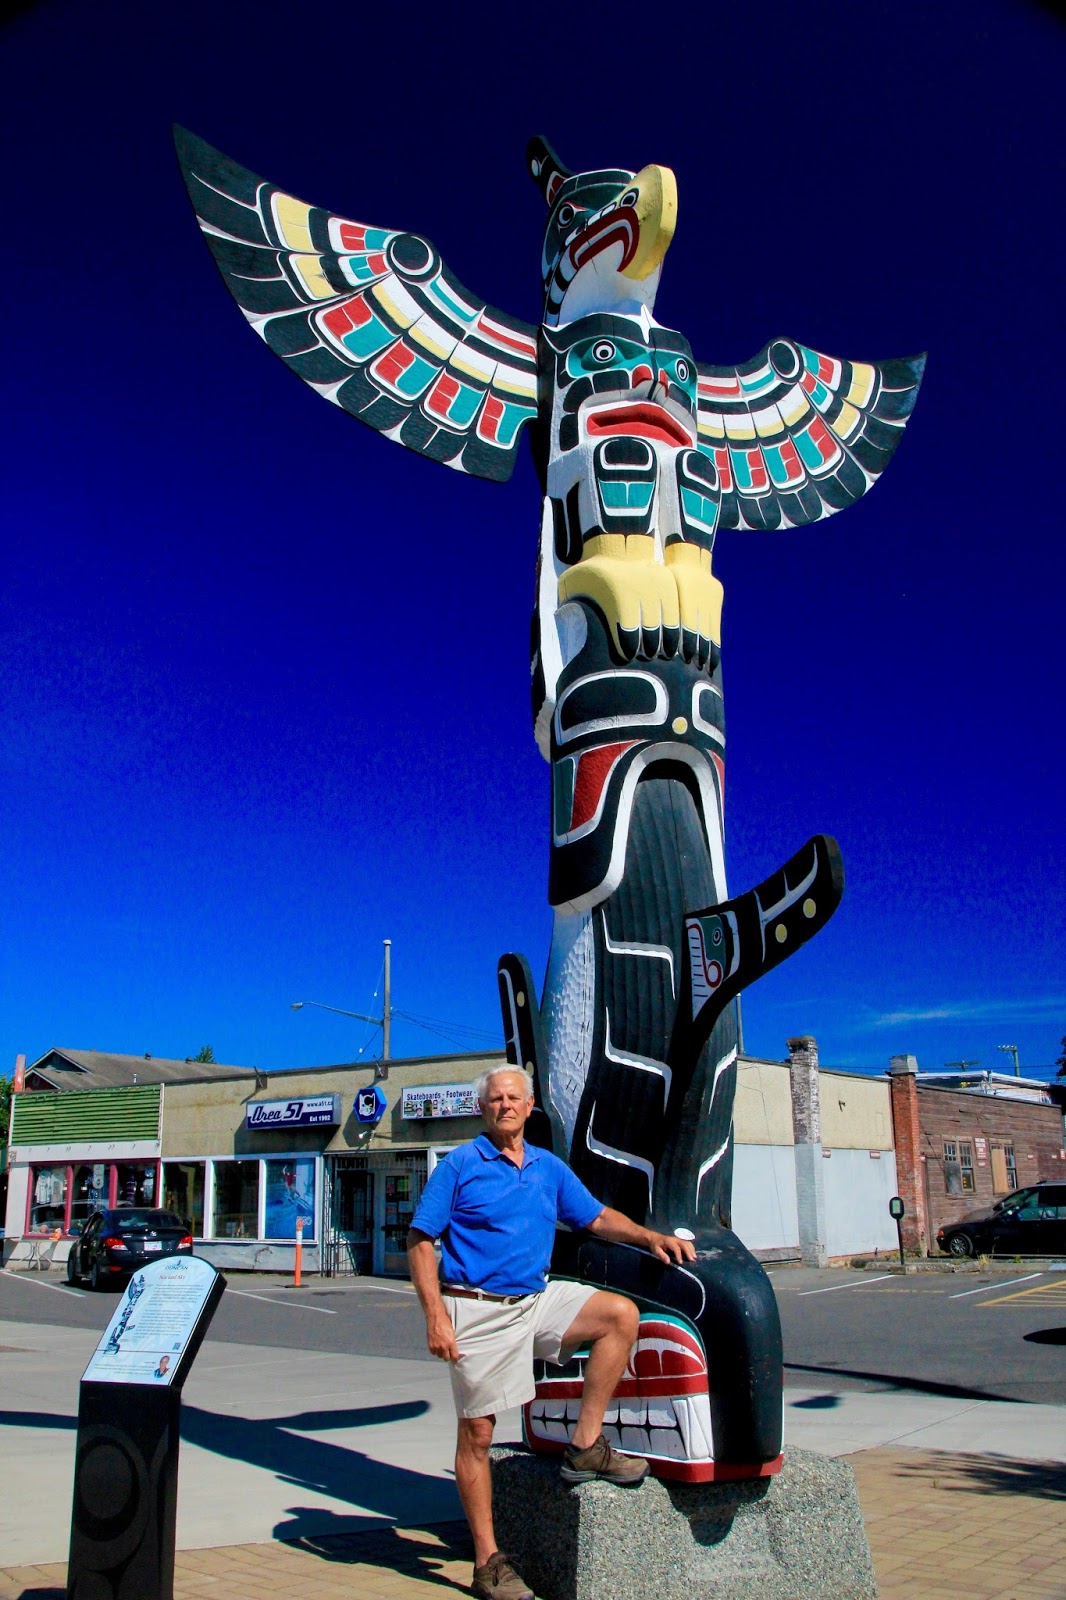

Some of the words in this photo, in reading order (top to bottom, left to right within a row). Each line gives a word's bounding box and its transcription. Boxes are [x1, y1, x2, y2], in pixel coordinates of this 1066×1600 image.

[407, 1092, 441, 1100] Skateboards
[446, 1090, 472, 1098] Footwear
[251, 1105, 281, 1123] Area
[281, 1102, 304, 1121] 51
